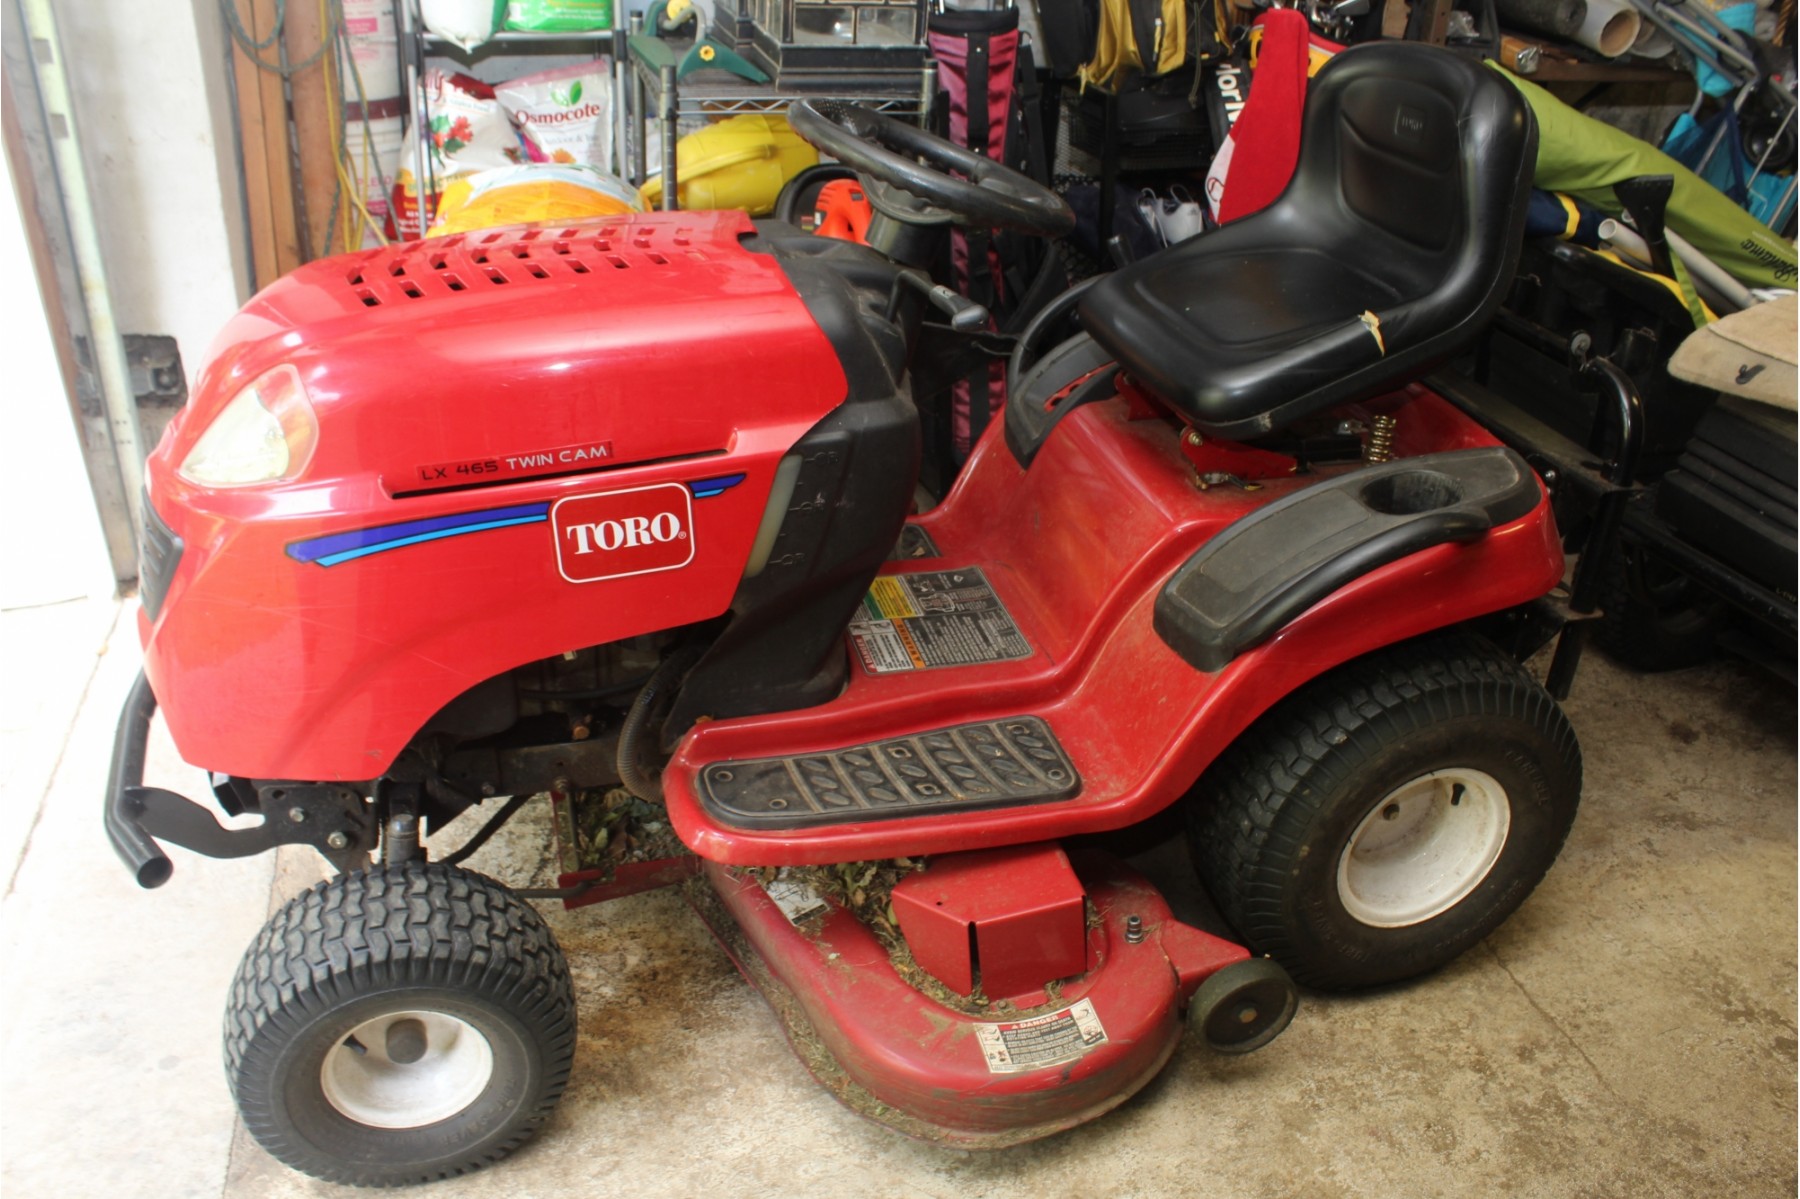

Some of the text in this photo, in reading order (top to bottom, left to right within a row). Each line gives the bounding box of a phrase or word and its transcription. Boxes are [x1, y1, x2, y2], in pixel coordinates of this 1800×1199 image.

[515, 103, 600, 125] Osmocote
[421, 445, 608, 482] LX 465 TWIN CAM
[565, 511, 681, 555] TORO
[1019, 1014, 1059, 1029] DANGER
